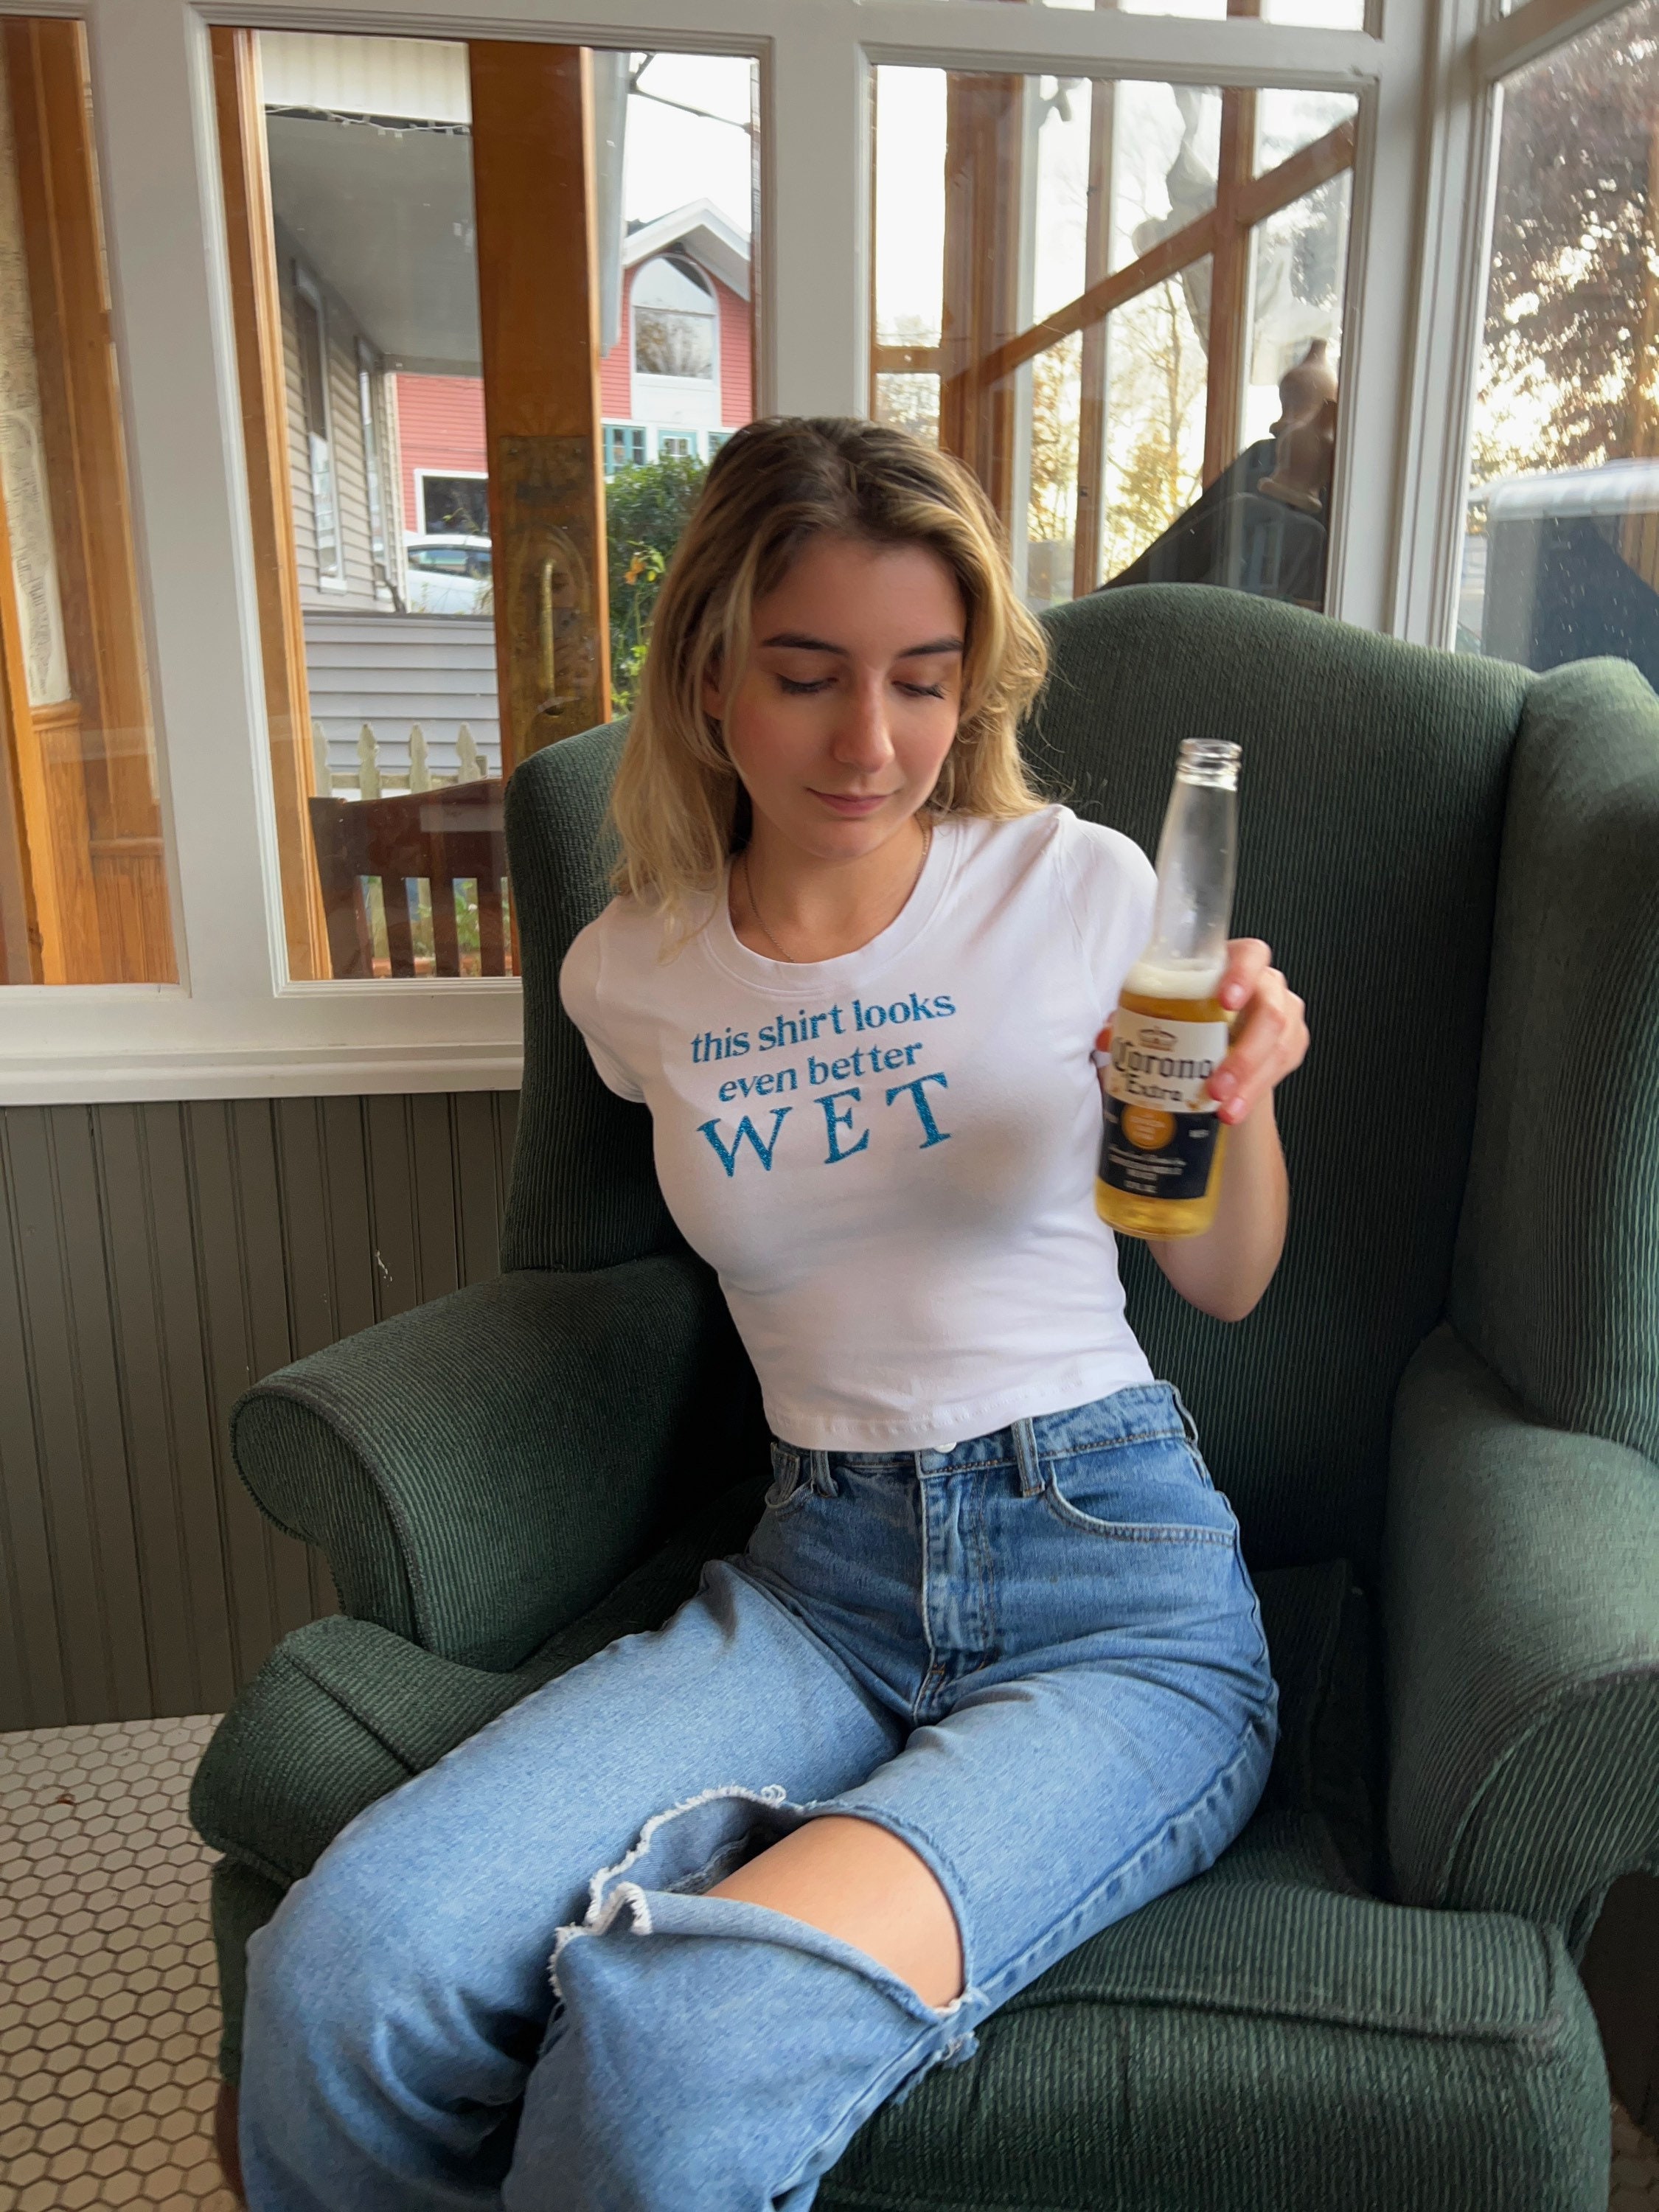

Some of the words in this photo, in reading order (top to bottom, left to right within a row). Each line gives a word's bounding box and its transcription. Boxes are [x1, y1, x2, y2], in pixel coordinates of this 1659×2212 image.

[690, 1027, 751, 1063] this
[758, 1004, 846, 1051] shirt
[852, 992, 956, 1032] looks
[718, 1068, 798, 1102] even
[807, 1042, 923, 1085] better
[1111, 1037, 1213, 1079] Corona
[1125, 1073, 1183, 1102] Extra
